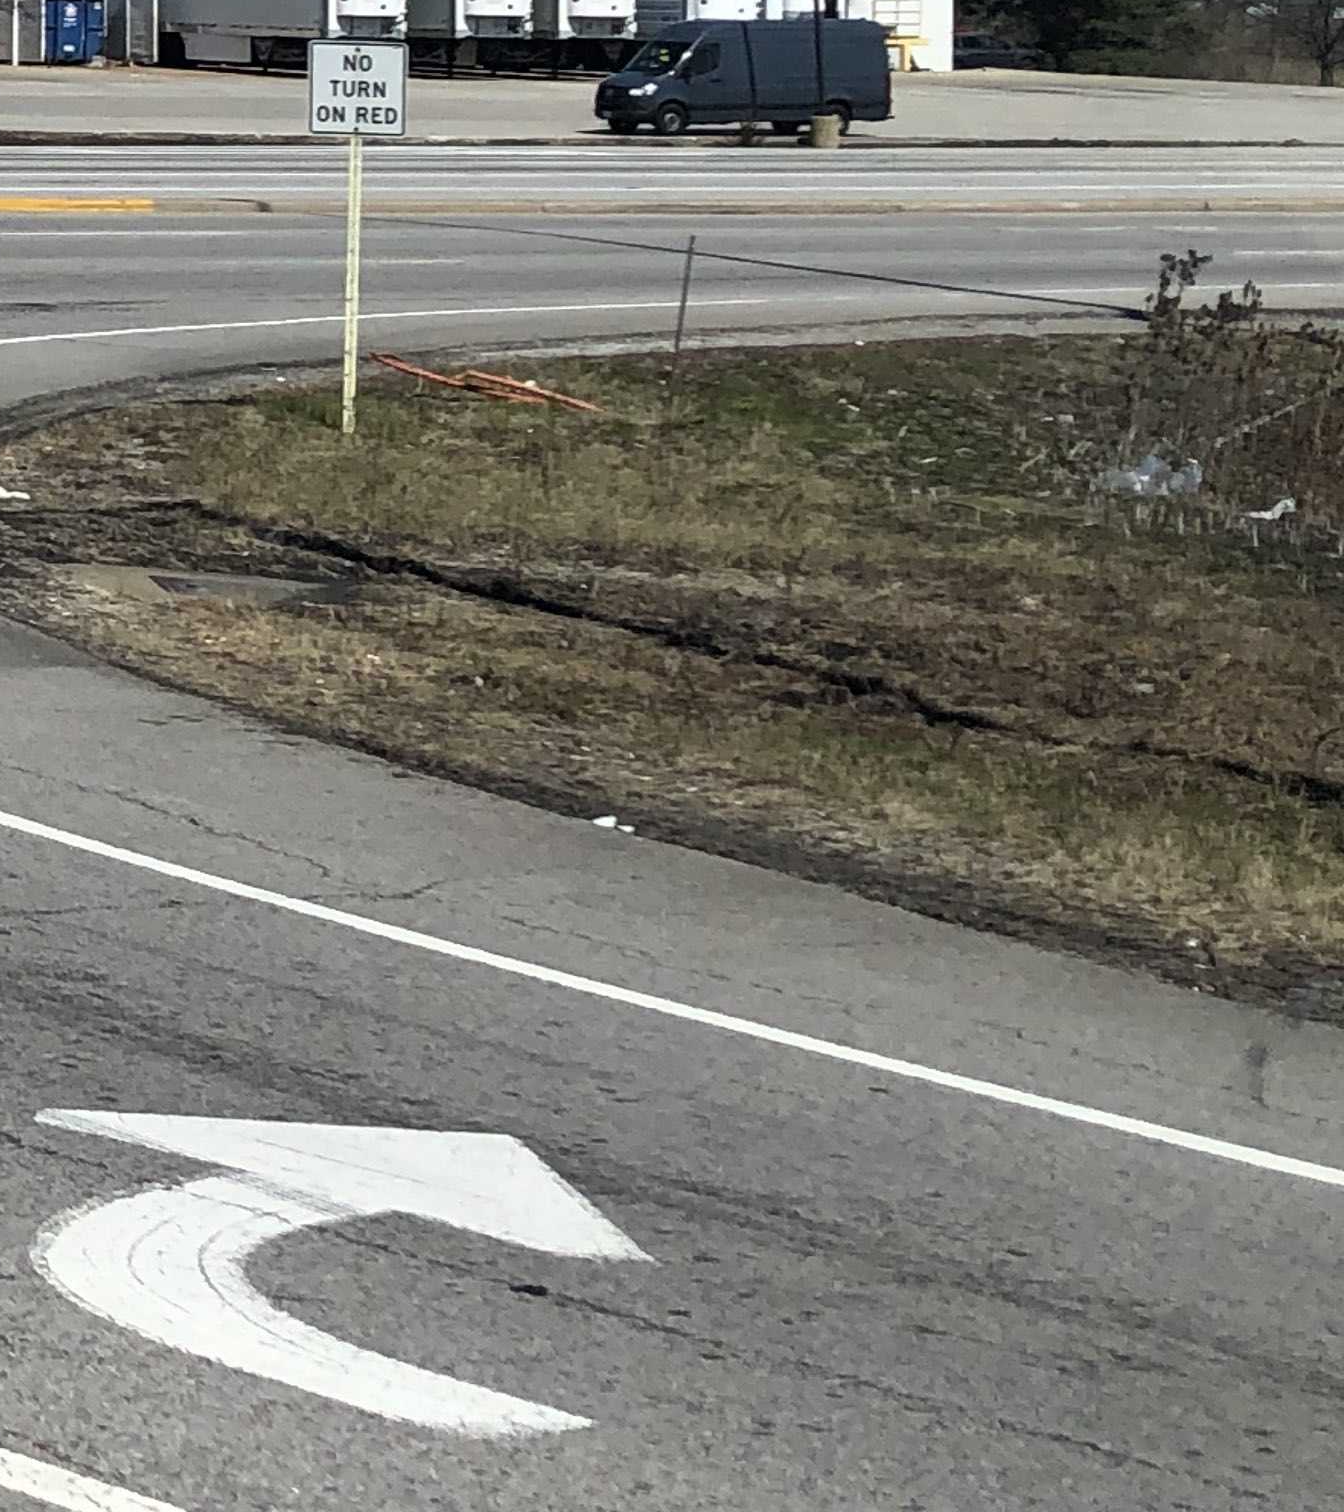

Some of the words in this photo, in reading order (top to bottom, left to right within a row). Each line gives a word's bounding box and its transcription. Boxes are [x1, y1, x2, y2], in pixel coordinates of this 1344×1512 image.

[343, 54, 373, 72] NO
[329, 79, 387, 98] TURN
[316, 105, 346, 123] ON
[355, 106, 398, 125] RED
